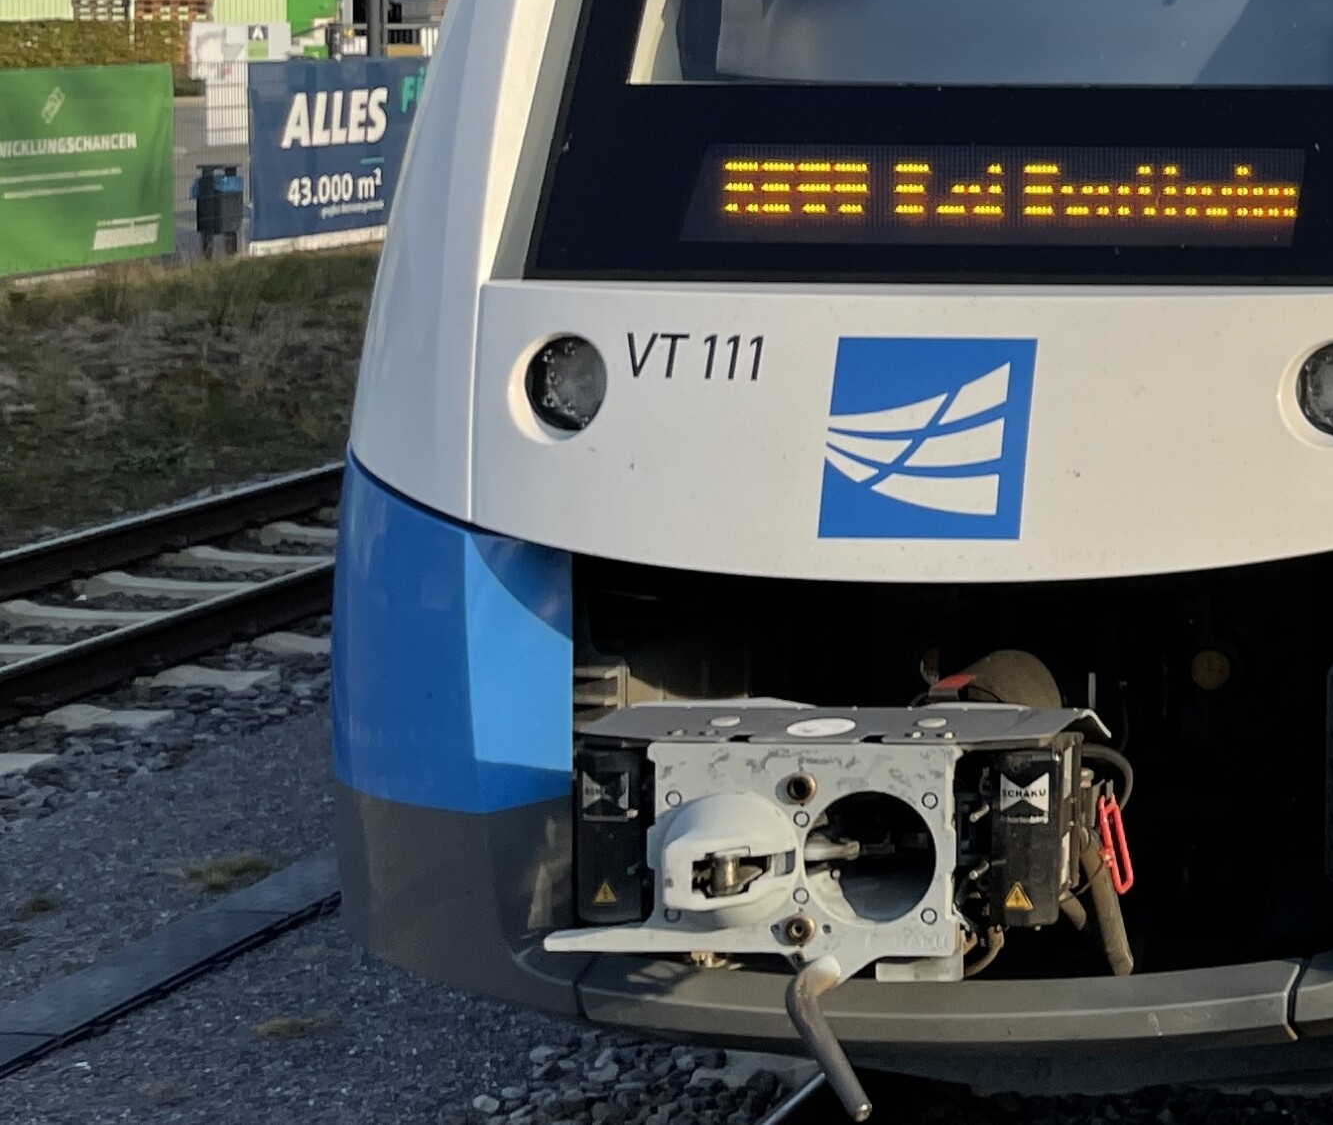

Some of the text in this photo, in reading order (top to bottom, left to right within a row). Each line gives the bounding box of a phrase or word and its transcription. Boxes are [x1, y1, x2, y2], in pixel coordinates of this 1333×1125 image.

[280, 85, 389, 150] ALLES
[287, 172, 353, 208] 43.000
[626, 331, 765, 381] VT 111
